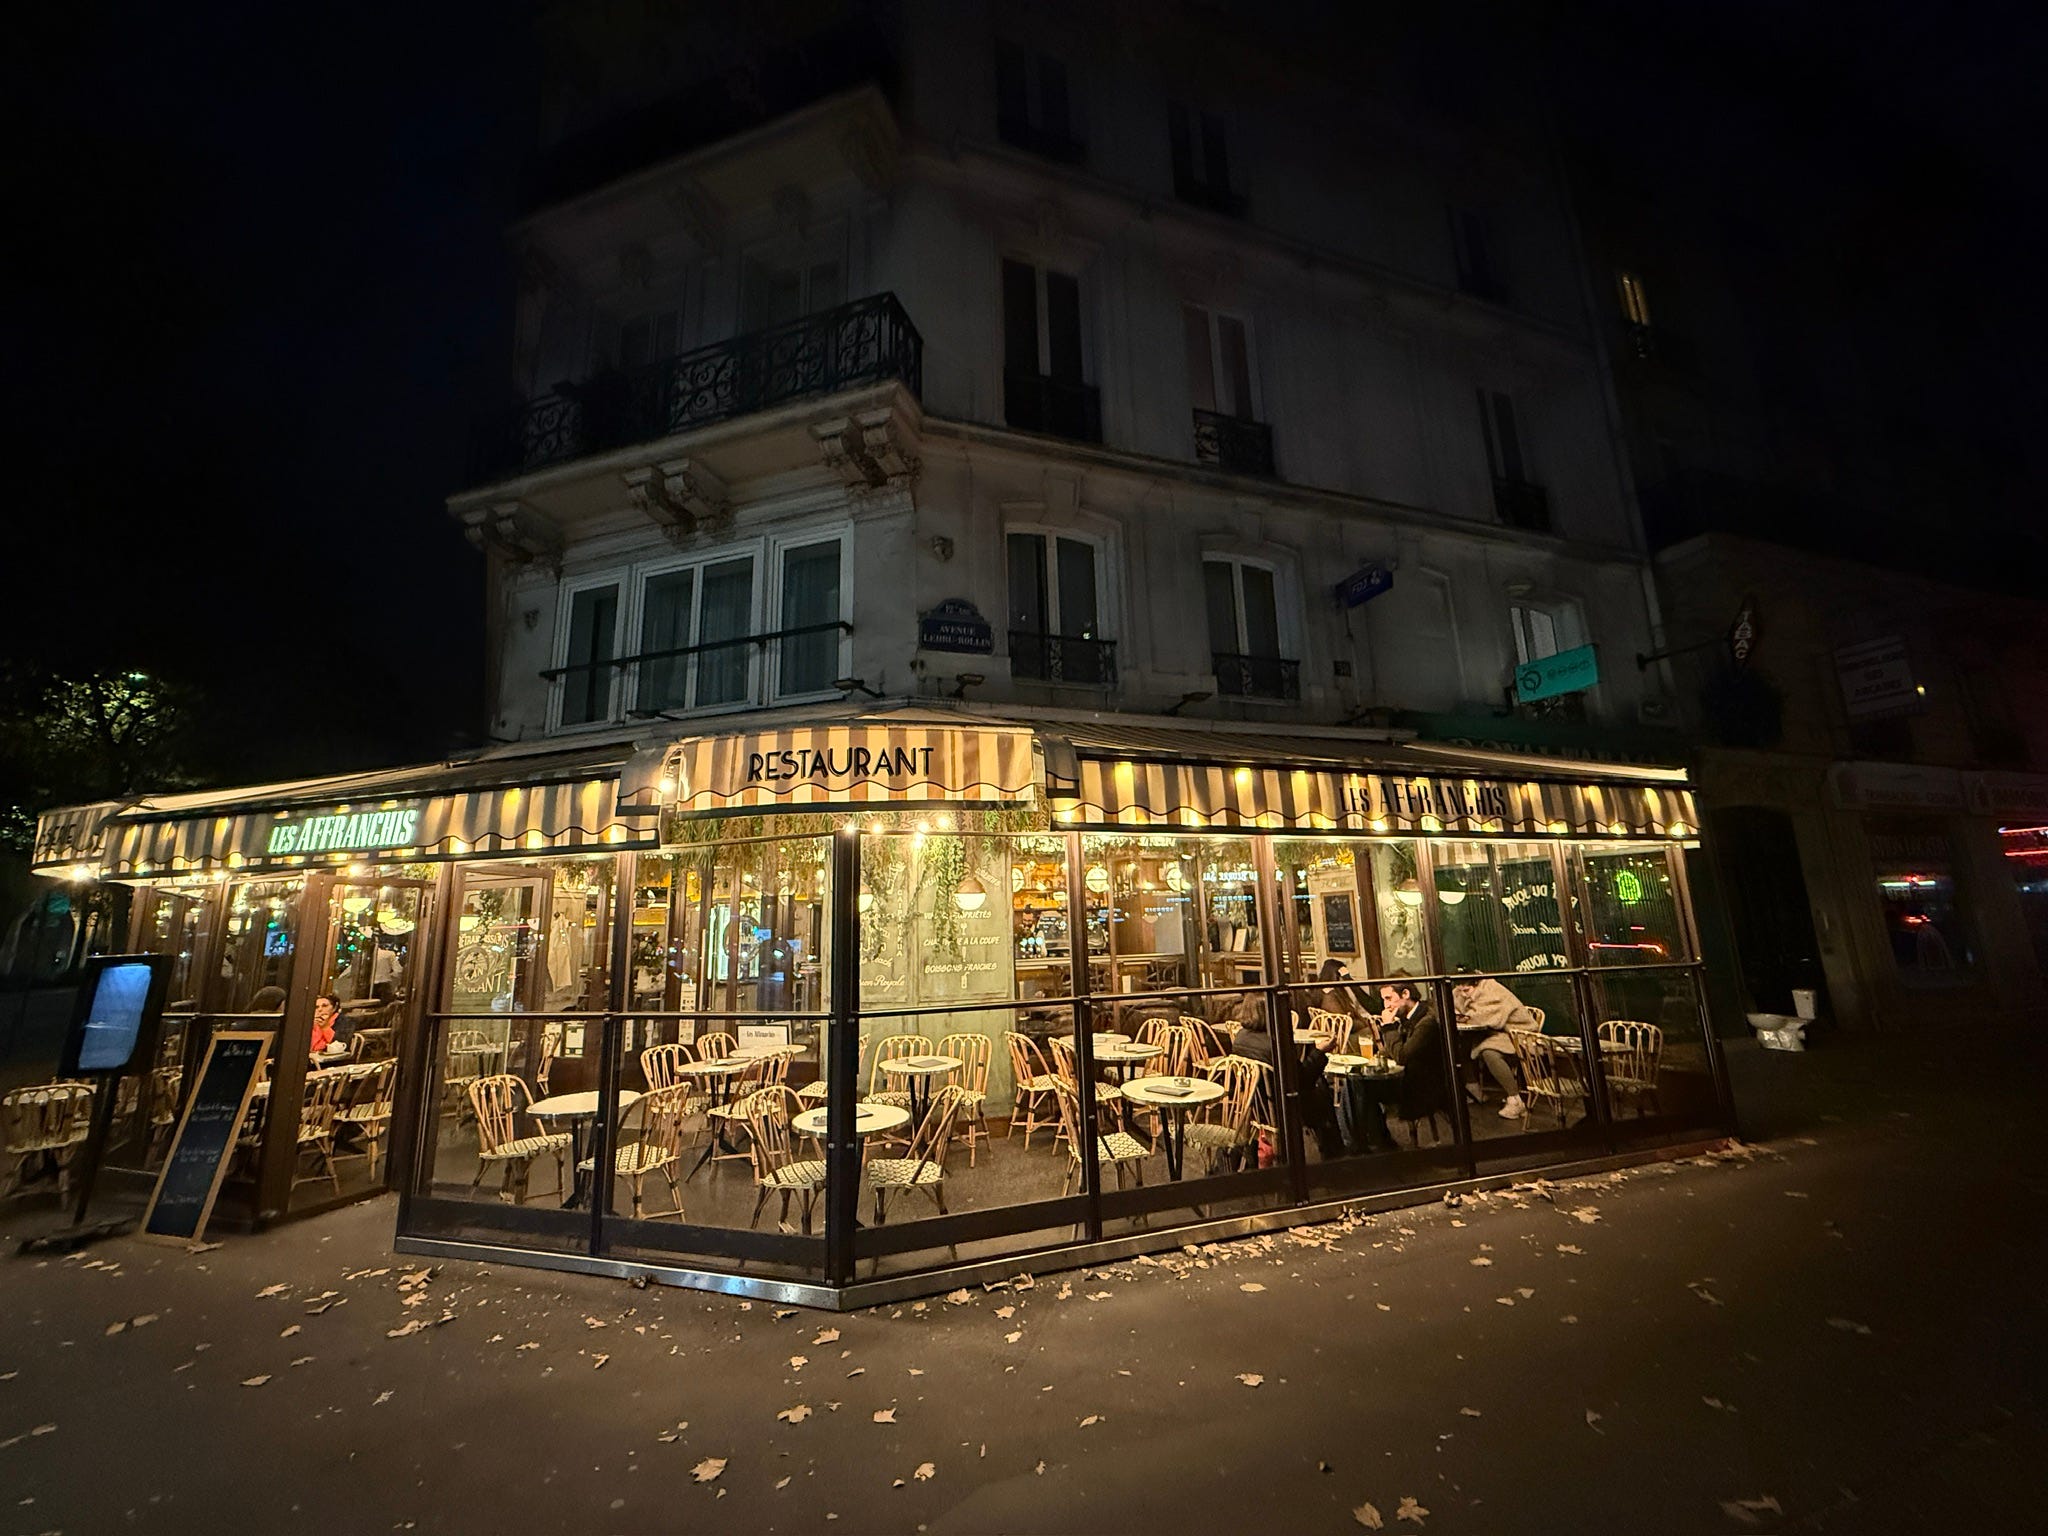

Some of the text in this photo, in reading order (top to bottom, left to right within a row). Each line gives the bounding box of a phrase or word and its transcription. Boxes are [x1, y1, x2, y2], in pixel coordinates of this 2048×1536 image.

[922, 633, 990, 647] LEDRU-ROLLIN
[940, 625, 975, 636] AVENUE
[1734, 609, 1753, 661] TABAC
[747, 747, 934, 782] RESTAURANT
[1339, 782, 1507, 816] LES AFFRANCHIS
[268, 809, 419, 853] LES AFFRANCHIS
[963, 937, 969, 945] A
[970, 937, 978, 945] LA
[979, 936, 1000, 945] COUPE
